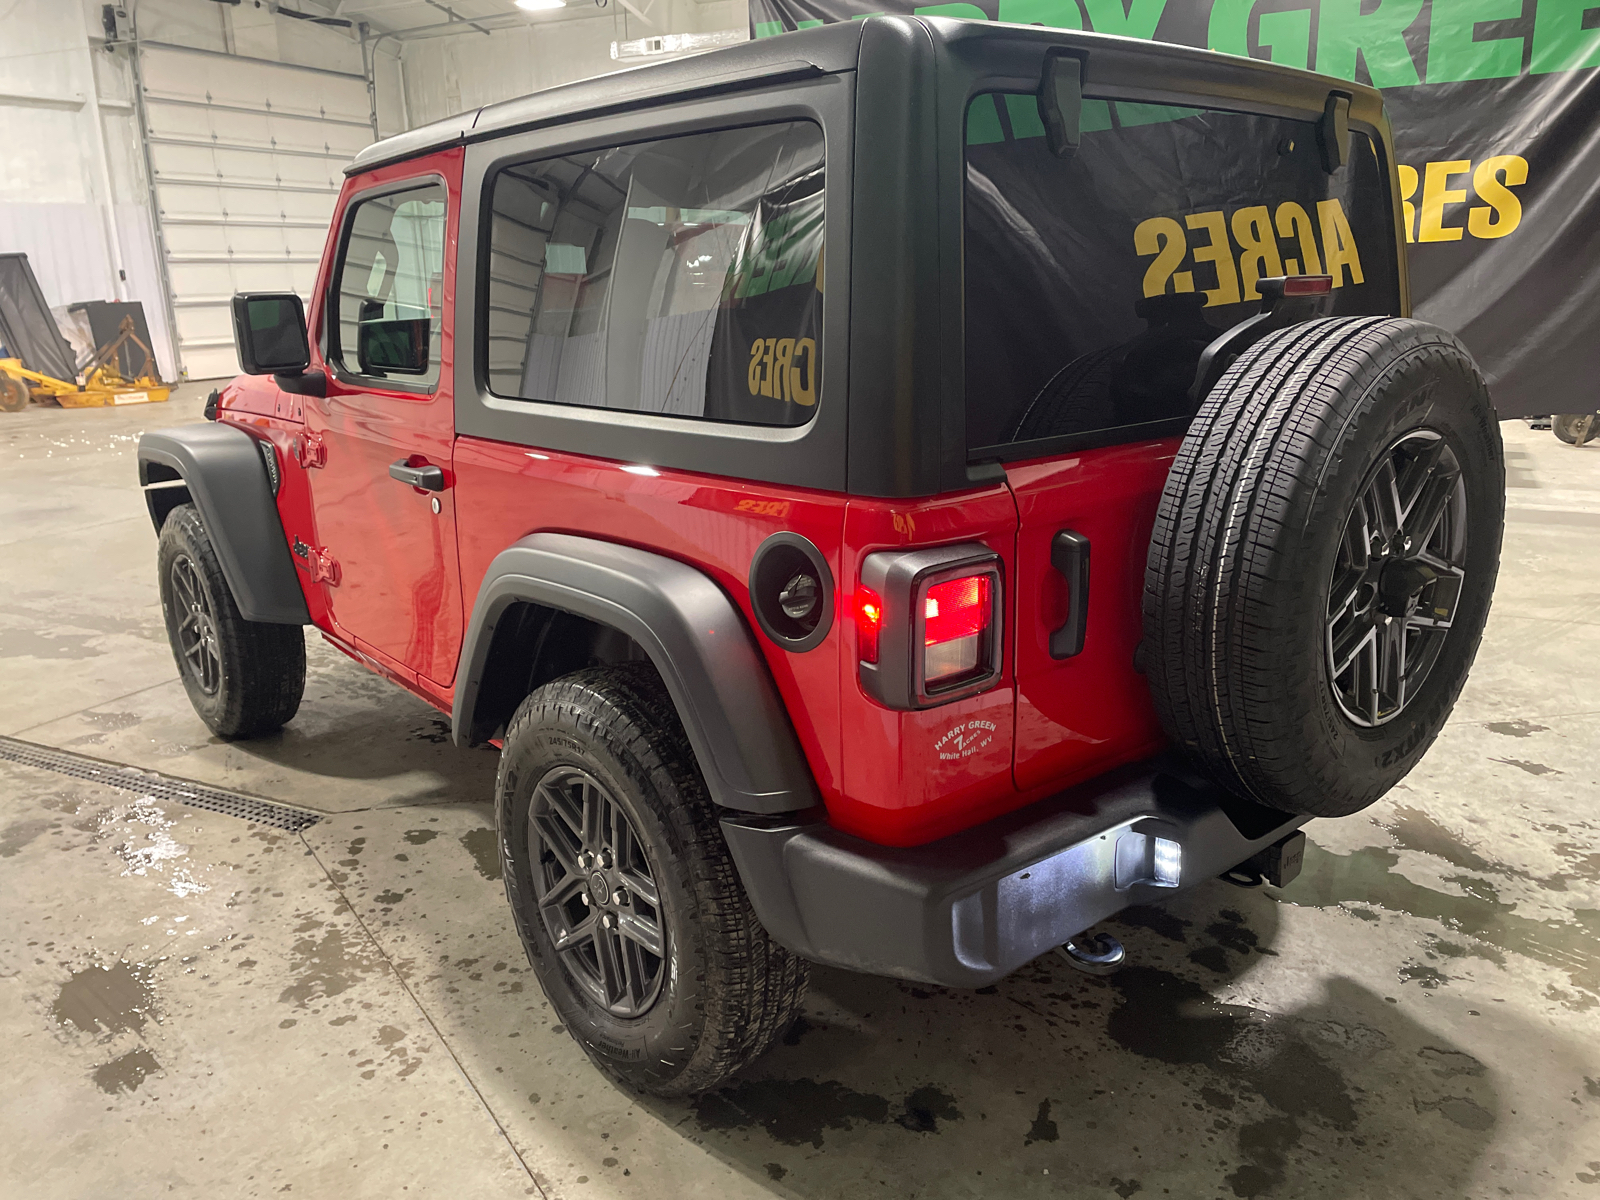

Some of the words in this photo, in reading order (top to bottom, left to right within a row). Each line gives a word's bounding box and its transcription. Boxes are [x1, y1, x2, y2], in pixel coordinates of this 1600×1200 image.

[934, 724, 965, 750] HARRY
[968, 720, 996, 731] GREEN
[953, 734, 963, 750] 7
[963, 730, 980, 747] ACRES
[548, 736, 586, 756] 245/75R17
[939, 752, 960, 760] White
[980, 735, 992, 747] WV
[597, 1041, 641, 1059] All-Weather
